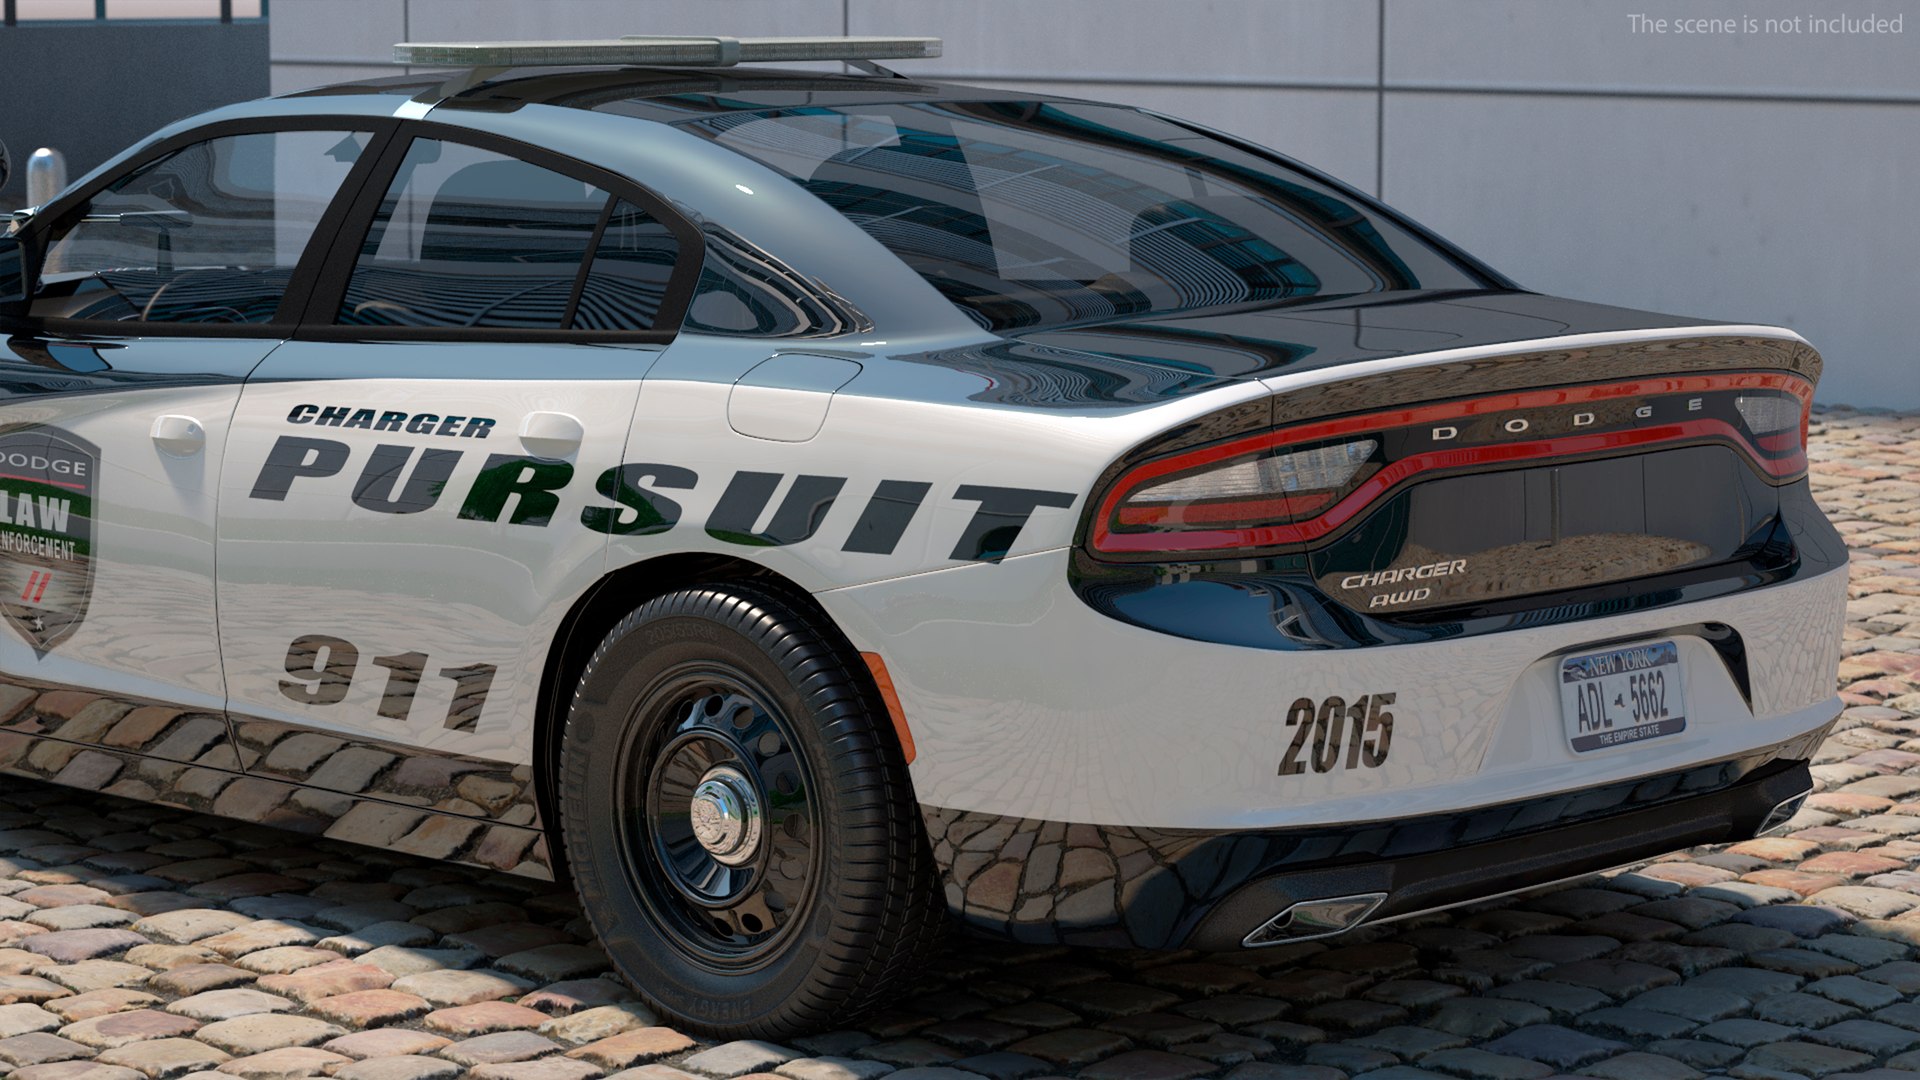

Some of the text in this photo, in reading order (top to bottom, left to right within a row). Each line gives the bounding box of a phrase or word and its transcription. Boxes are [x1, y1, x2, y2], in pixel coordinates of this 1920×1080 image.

[286, 403, 497, 439] CHARGER
[1432, 397, 1703, 440] DODGE
[0, 489, 71, 533] LAW
[249, 435, 1079, 565] PURSUIT
[0, 530, 76, 561] NFORCEMENT
[1341, 558, 1467, 590] CHARGER
[1369, 587, 1431, 608] AWD
[1589, 648, 1652, 677] NEW YORK
[278, 634, 498, 734] 911
[1577, 670, 1669, 734] ADL 5662
[1277, 692, 1397, 776] 2015
[1599, 723, 1660, 745] THE EMPIRE STATE
